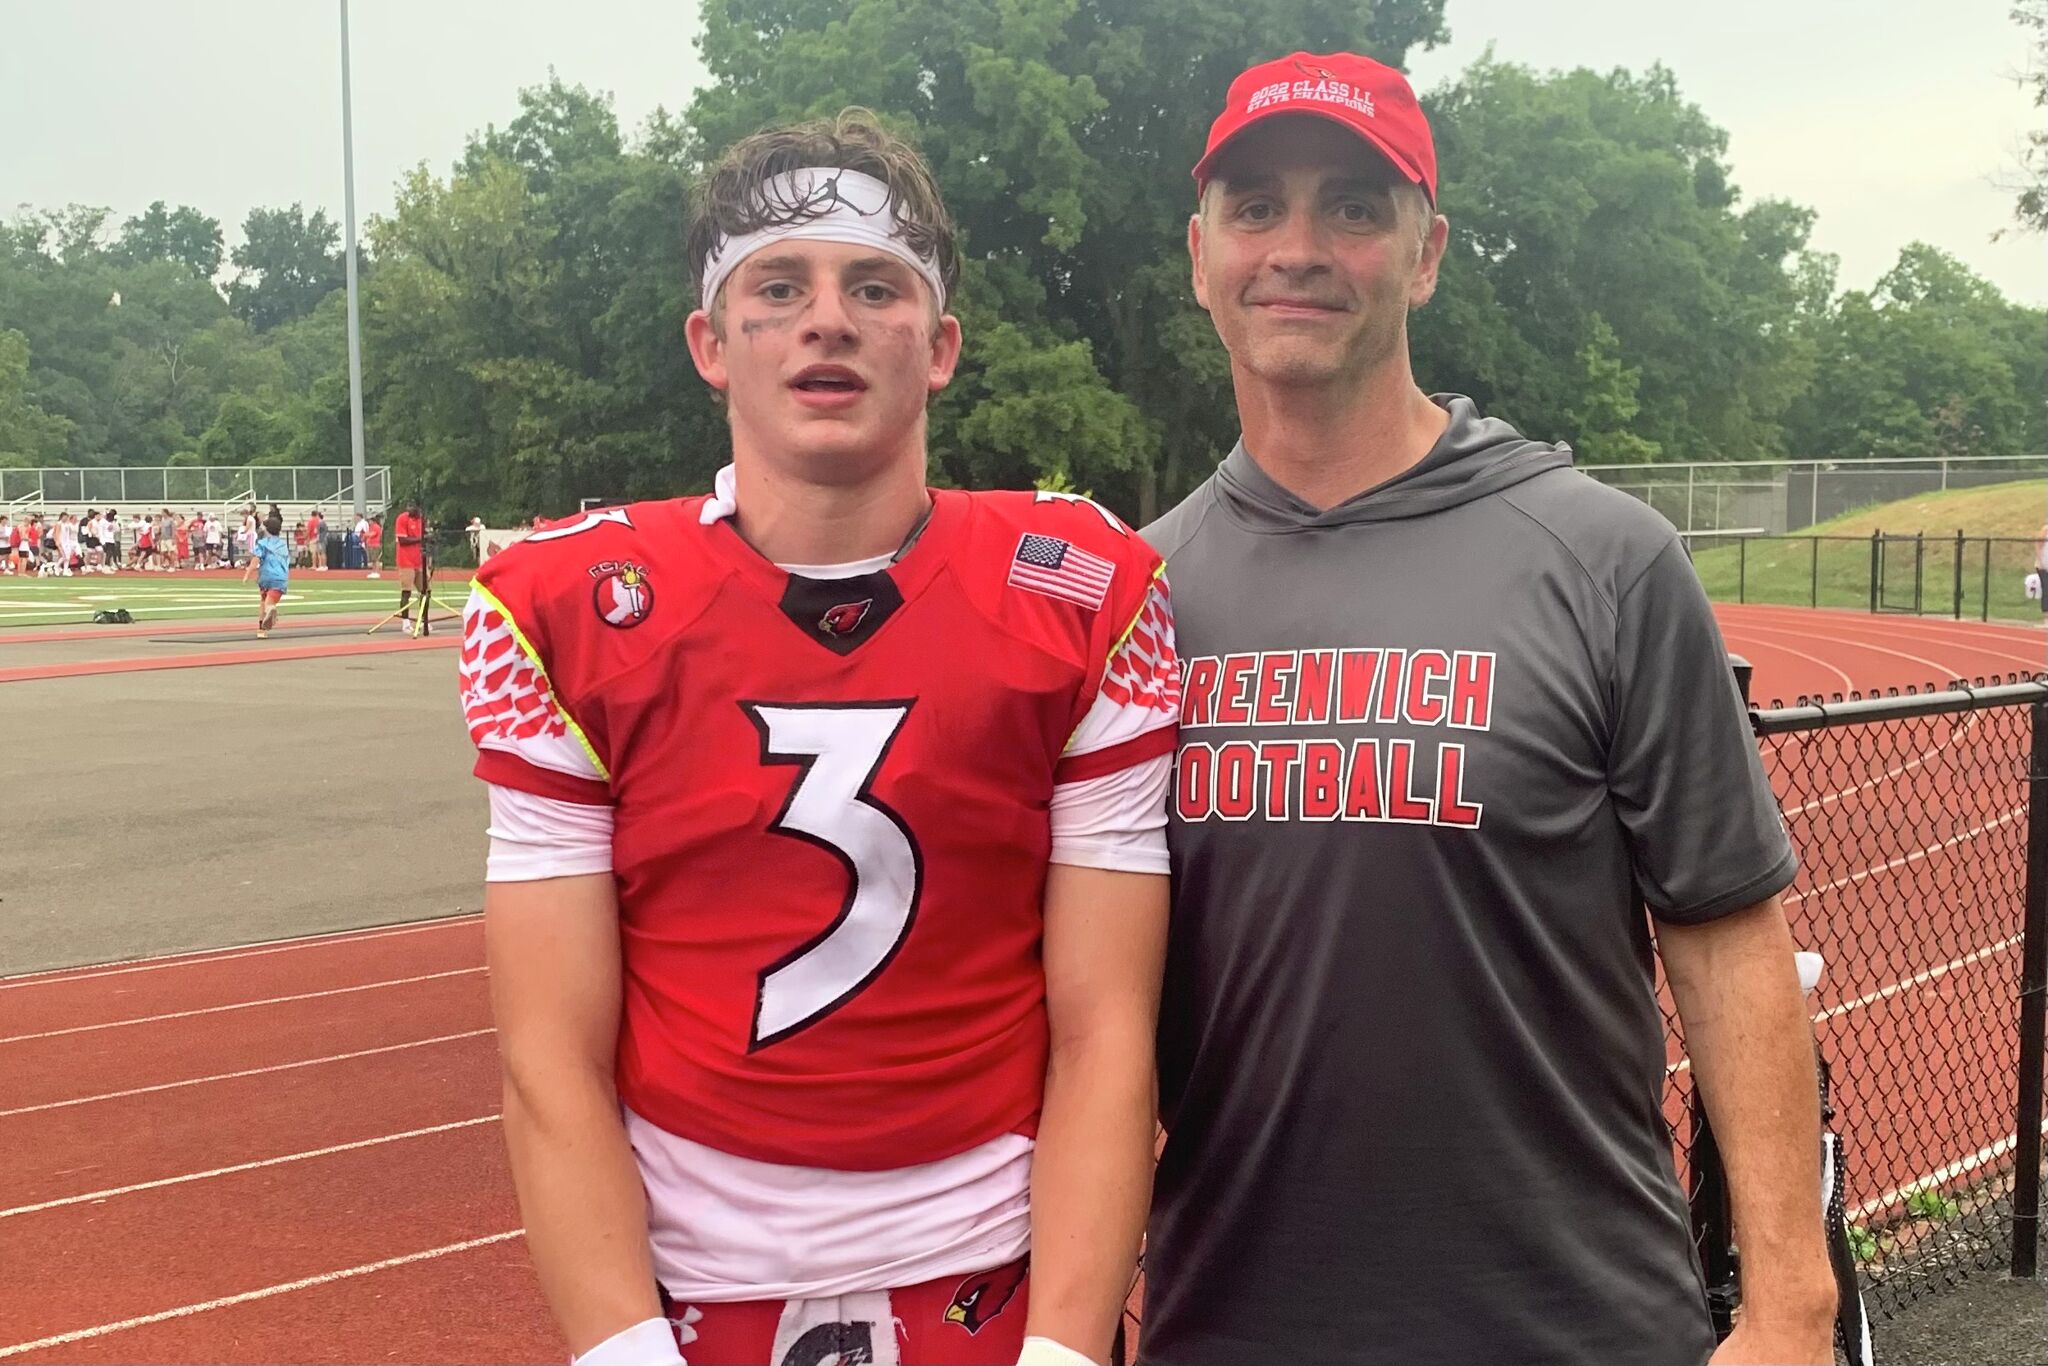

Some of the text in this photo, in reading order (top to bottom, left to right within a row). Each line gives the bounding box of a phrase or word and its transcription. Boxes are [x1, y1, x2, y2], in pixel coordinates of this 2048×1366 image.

[1246, 92, 1375, 118] STATE CHAMPIONS
[1249, 80, 1375, 107] 2022 CLASS LL
[1178, 648, 1496, 731] REENWICH
[1169, 738, 1483, 829] OOTBALL
[736, 697, 924, 1055] 3
